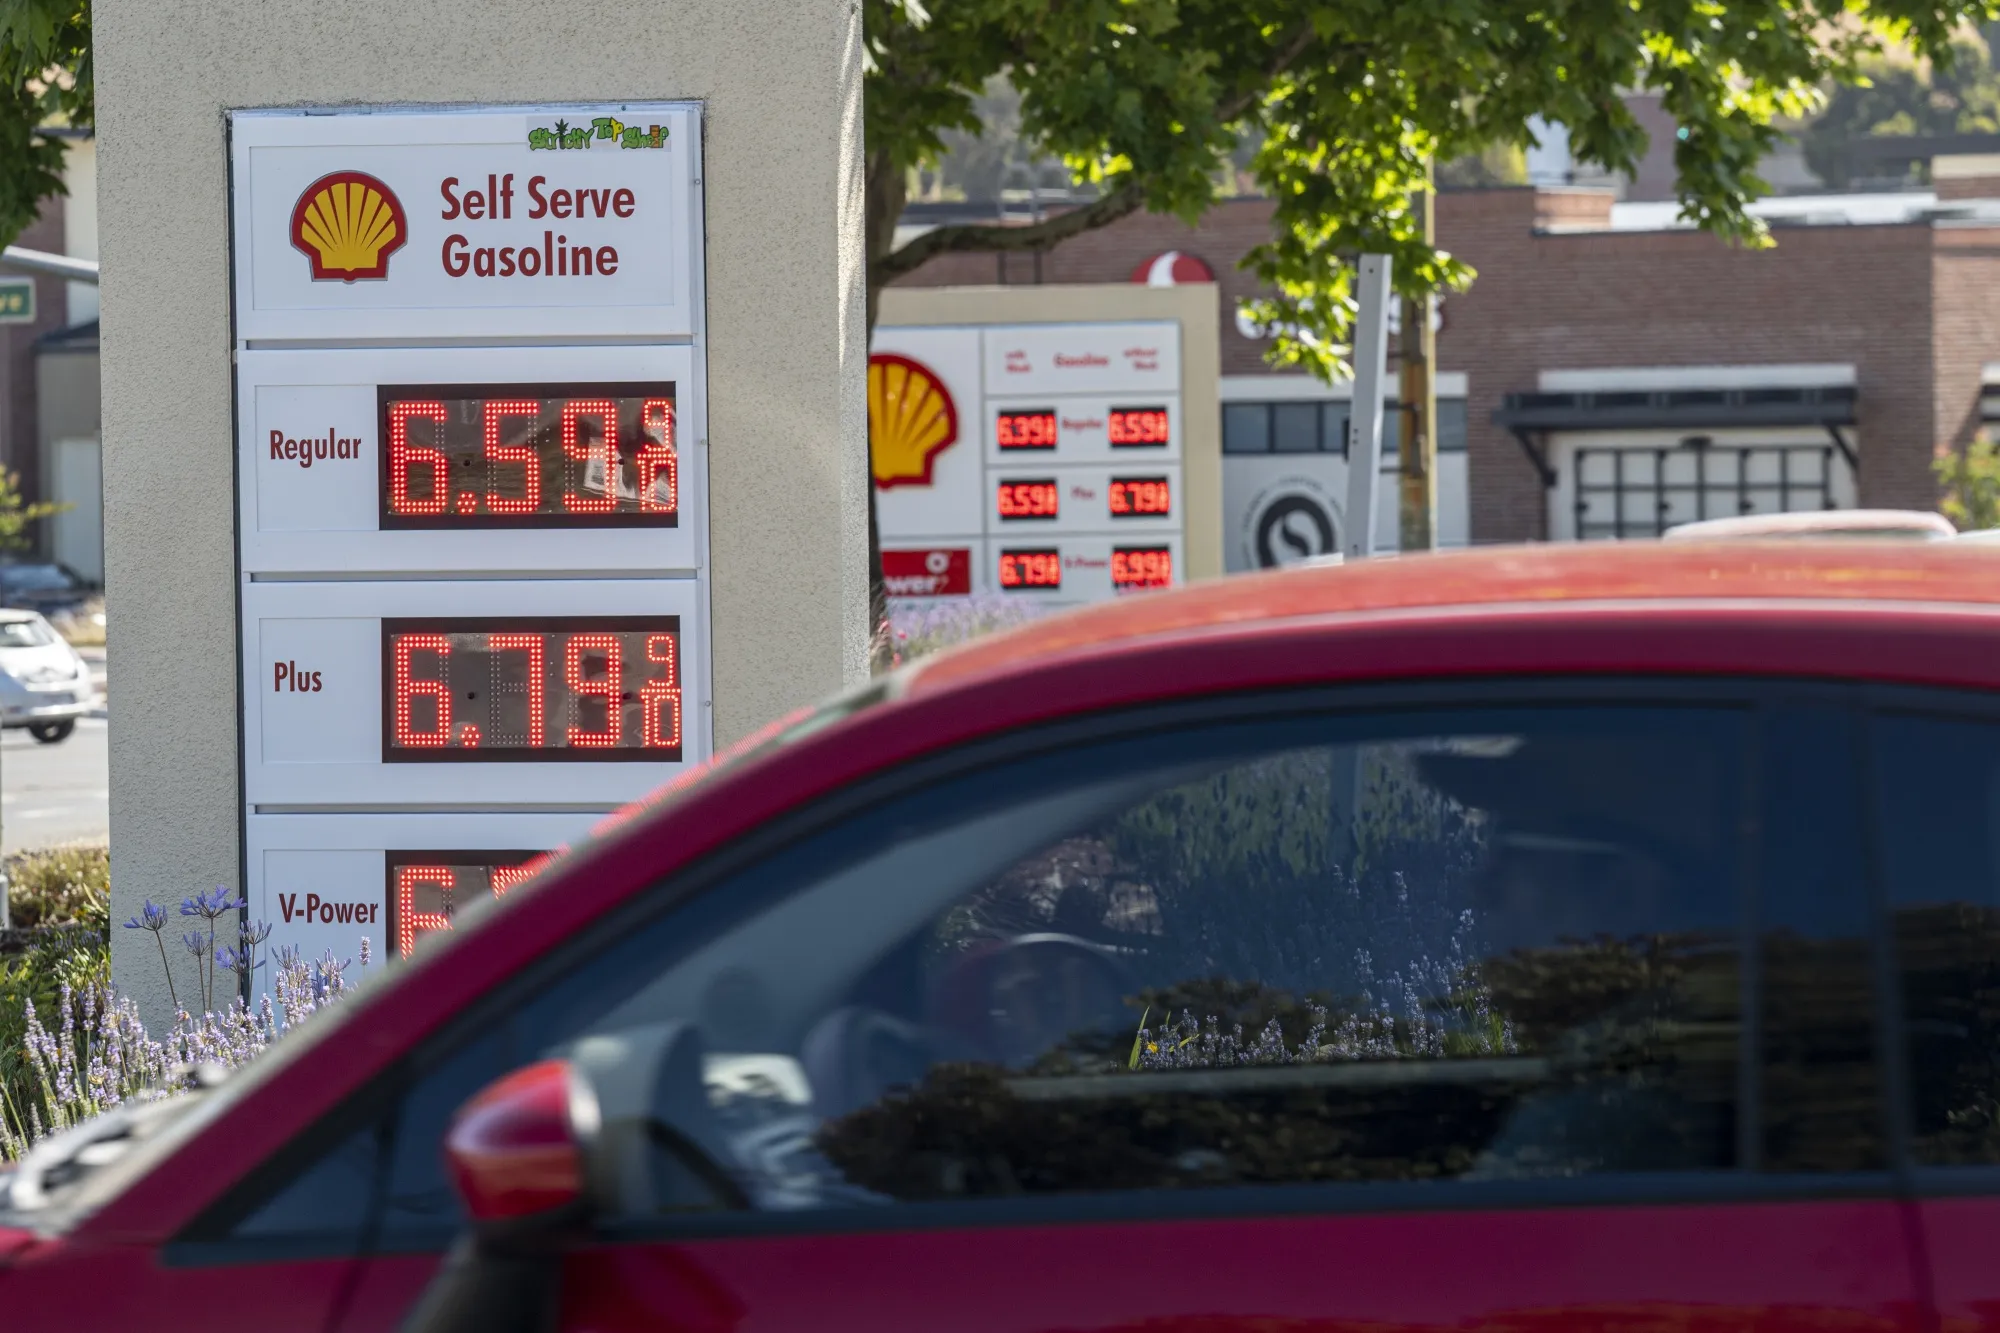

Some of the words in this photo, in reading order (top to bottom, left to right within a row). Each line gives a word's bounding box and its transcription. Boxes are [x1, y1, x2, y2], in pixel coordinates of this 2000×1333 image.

[440, 173, 514, 220] Self
[527, 175, 636, 220] Serve
[441, 230, 619, 278] Gasoline
[269, 427, 362, 468] Regular
[274, 660, 323, 693] Plus
[278, 892, 379, 924] V-Power
